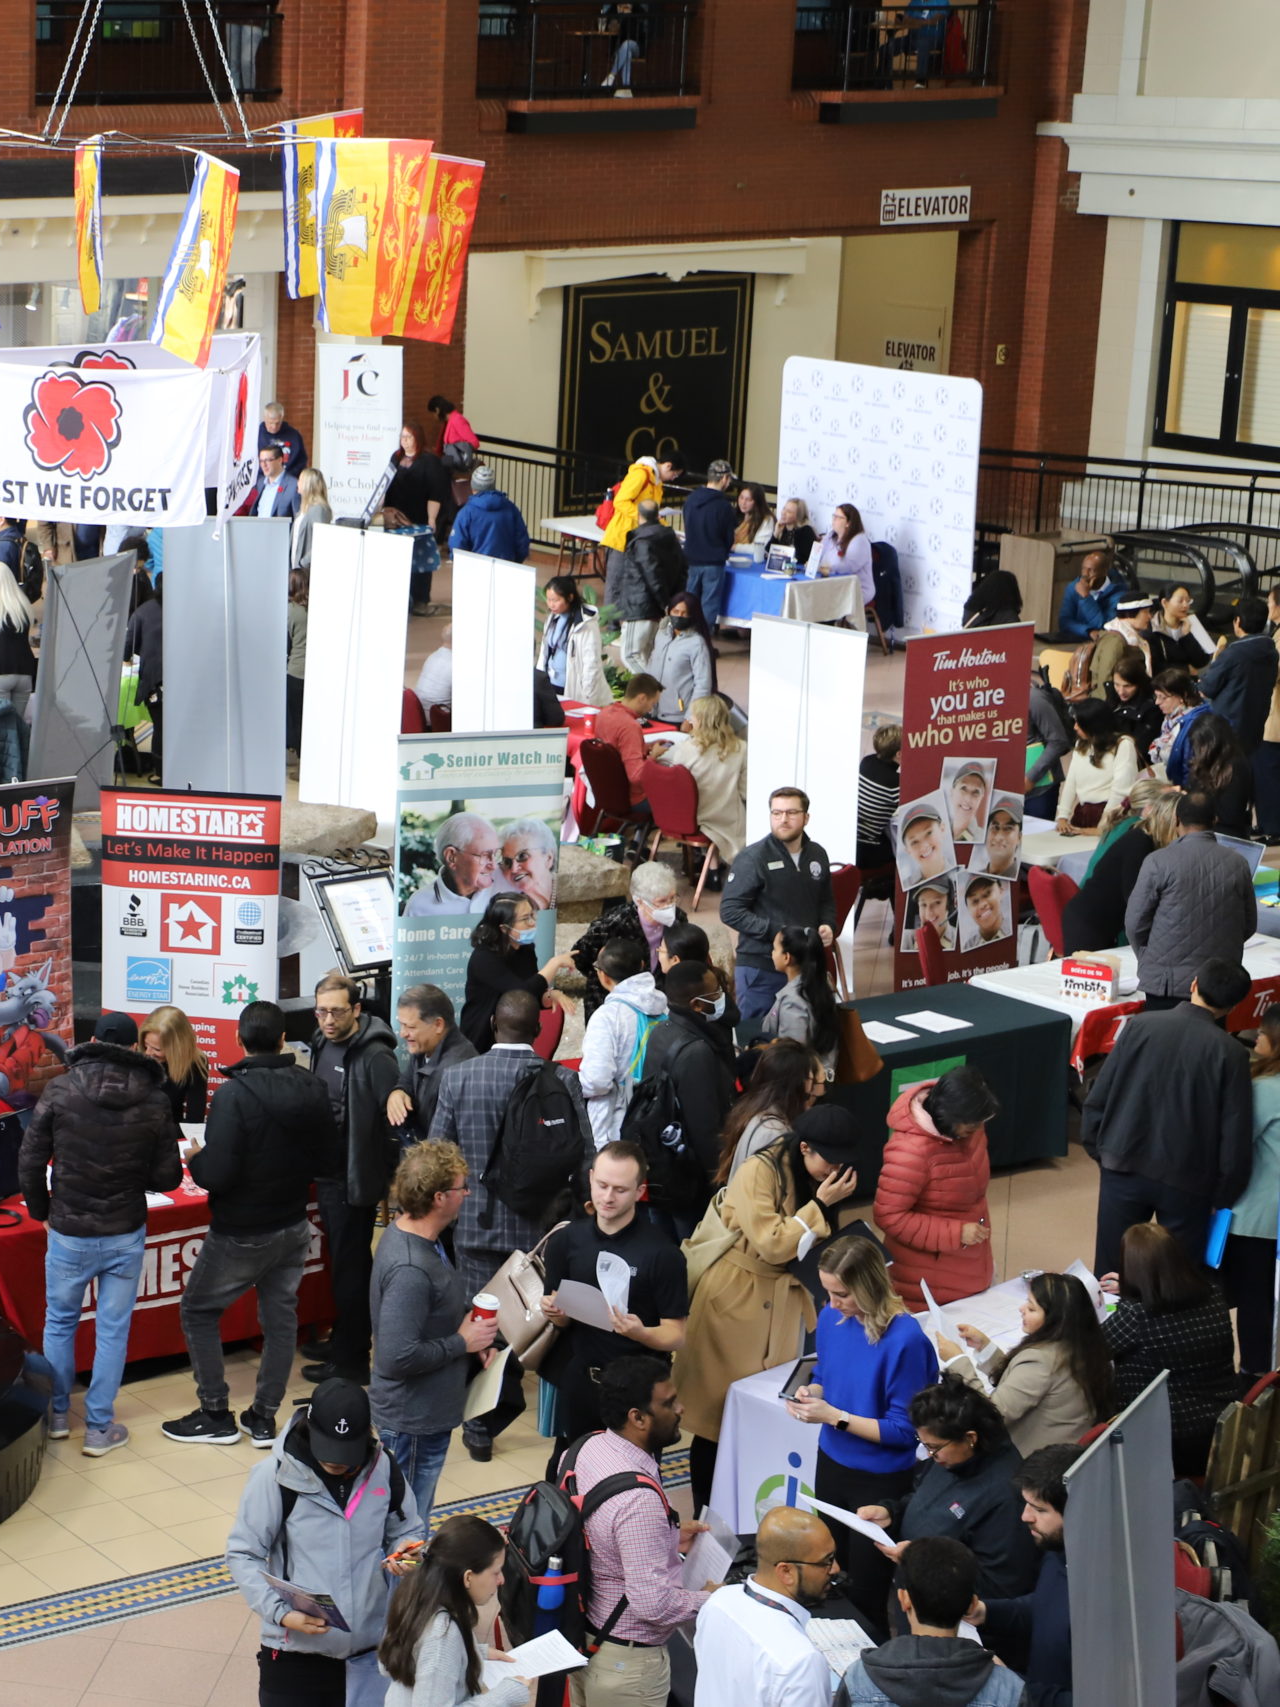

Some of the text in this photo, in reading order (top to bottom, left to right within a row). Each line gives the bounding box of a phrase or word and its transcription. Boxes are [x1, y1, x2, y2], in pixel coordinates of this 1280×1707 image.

[898, 195, 968, 217] ELEVATOR
[589, 321, 728, 364] SAMUEL
[885, 340, 936, 362] ELEVATOR
[640, 372, 673, 414] &
[36, 482, 72, 508] WE
[80, 486, 172, 512] FORGET
[932, 647, 1007, 672] Tim Hortons
[948, 676, 989, 692] It's who
[930, 687, 1005, 720] you are
[937, 709, 998, 726] that makes us
[907, 718, 1023, 749] who we are
[446, 753, 493, 768] Senior
[497, 751, 542, 766] Watch
[117, 805, 240, 836] HOMESTAR
[107, 840, 274, 865] Let's Make It Happen
[128, 869, 251, 889] HOMESTARINC.CA
[123, 917, 144, 927] BBB
[397, 926, 472, 943] Home Care
[426, 952, 459, 960] in-home
[404, 966, 464, 977] Attendant Care
[902, 979, 913, 988] It's
[914, 977, 927, 987] not
[962, 969, 972, 978] It's
[973, 966, 984, 975] the
[1064, 978, 1107, 993] timbits
